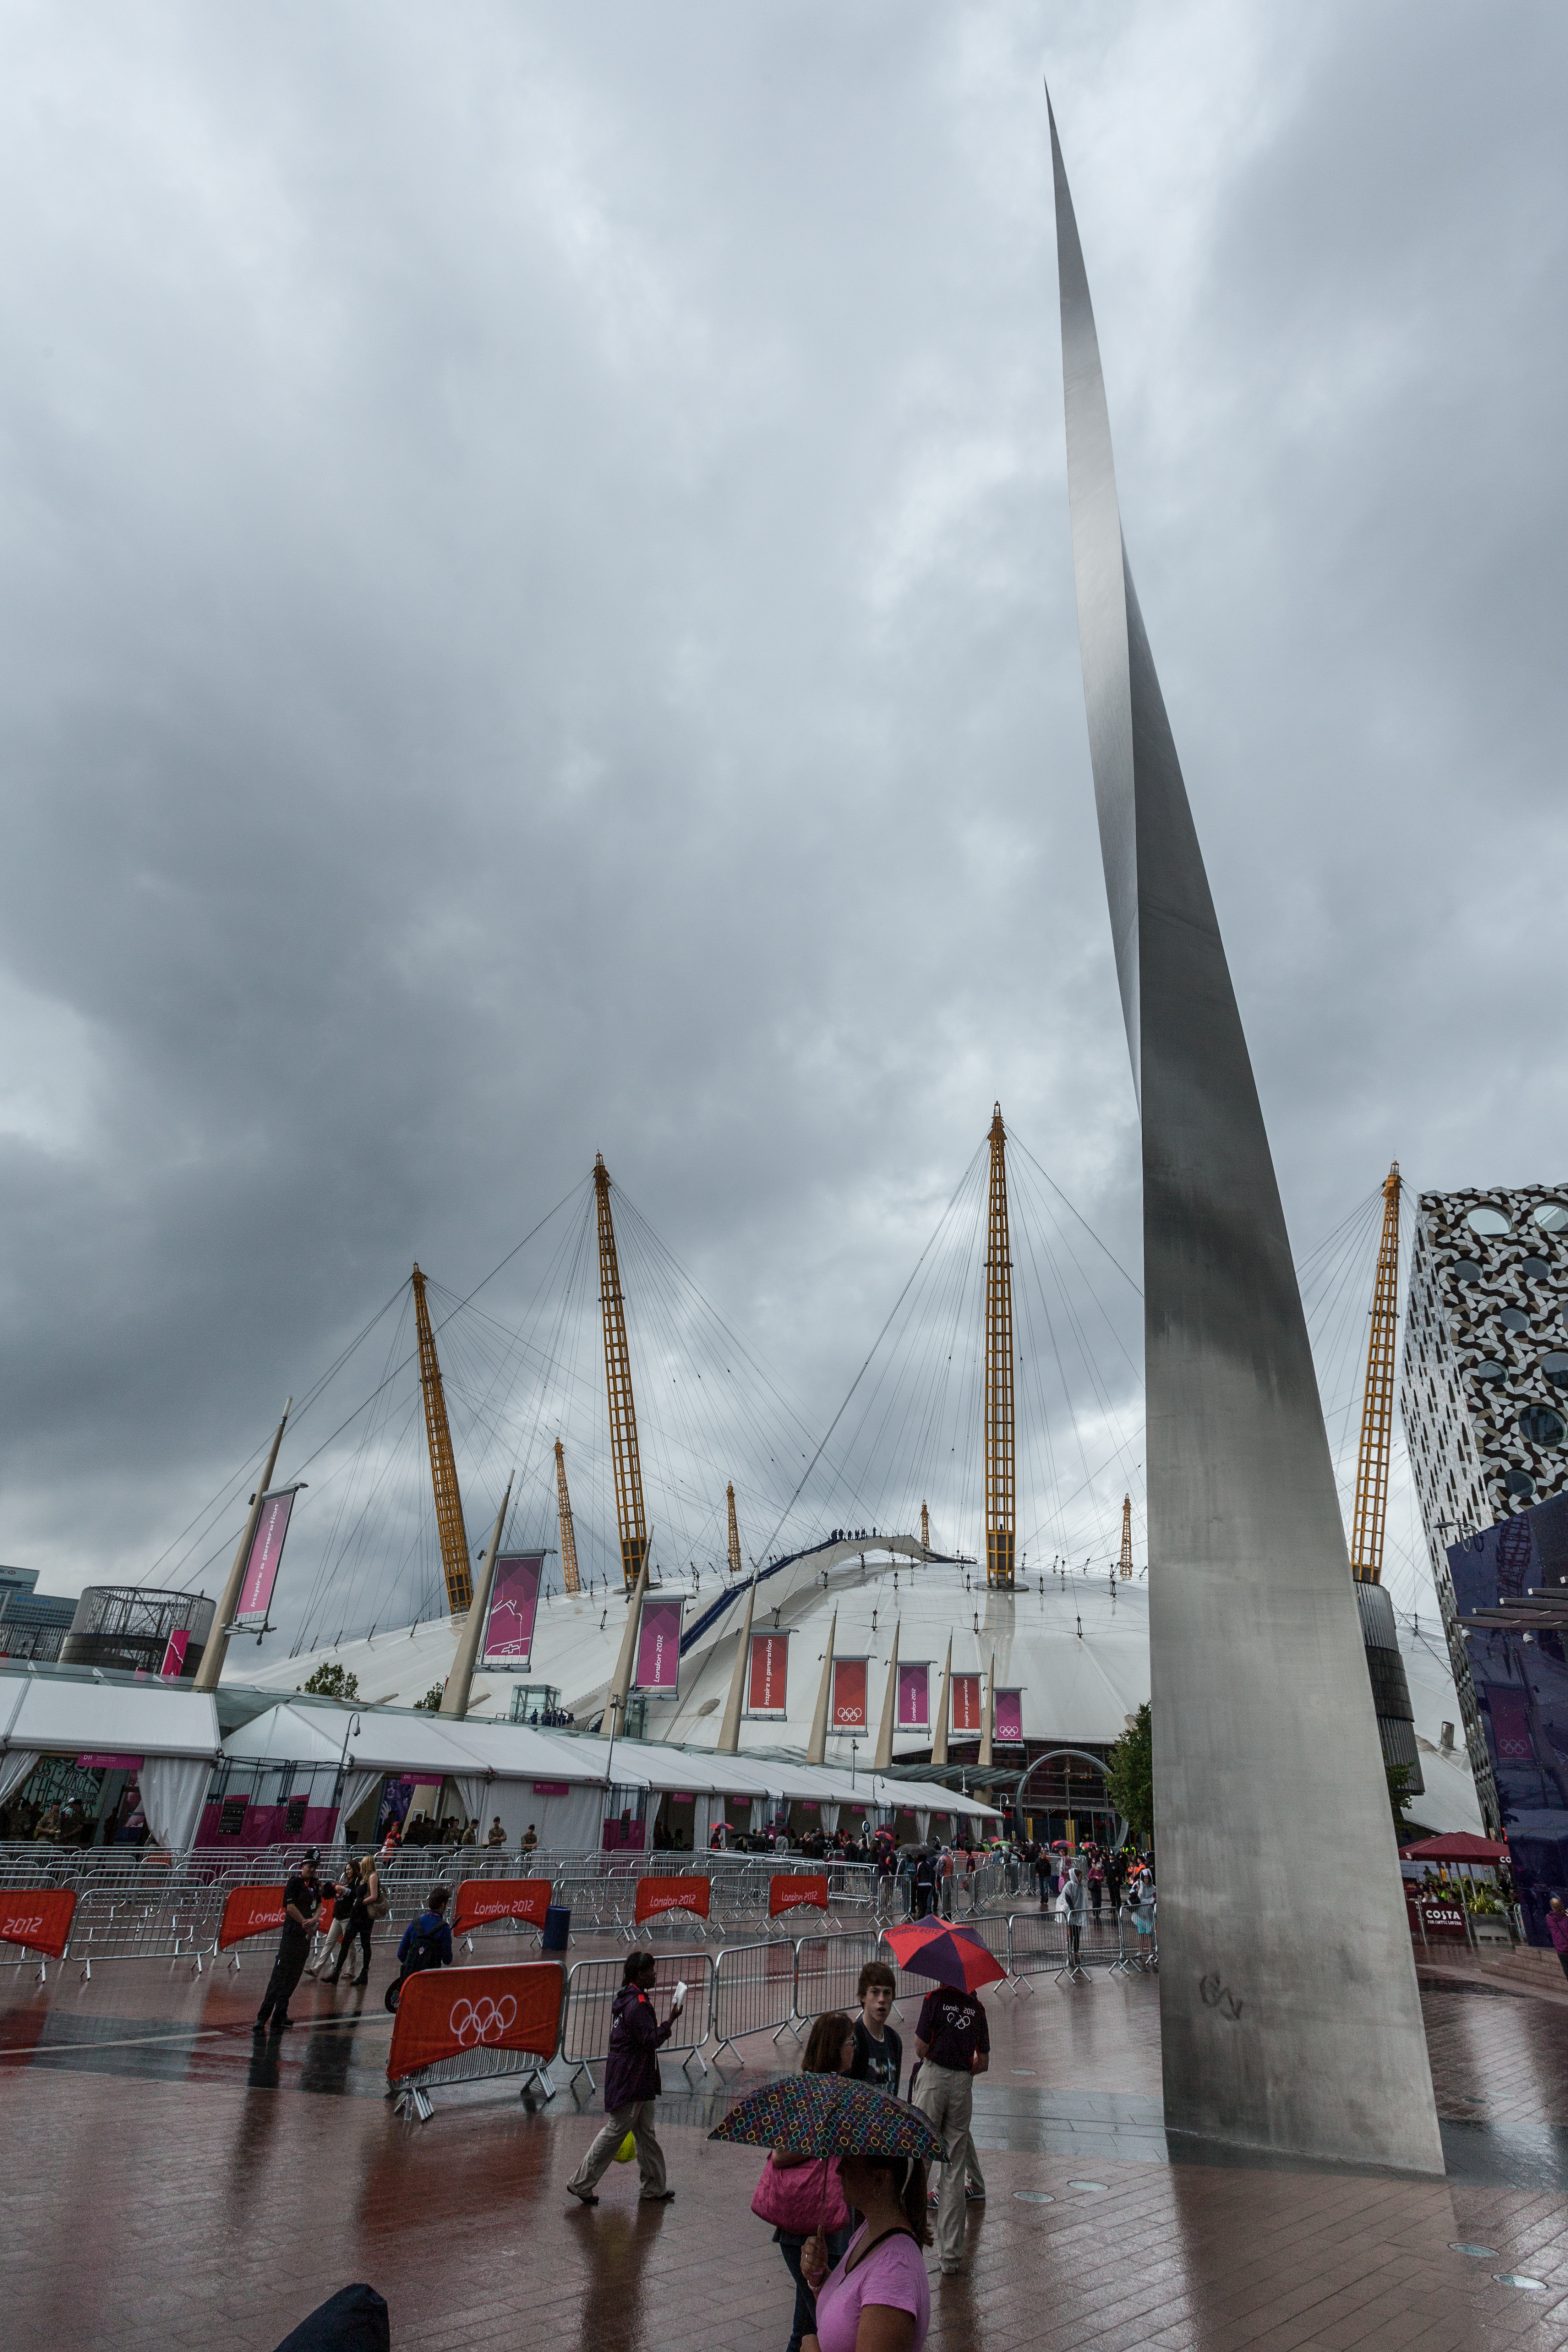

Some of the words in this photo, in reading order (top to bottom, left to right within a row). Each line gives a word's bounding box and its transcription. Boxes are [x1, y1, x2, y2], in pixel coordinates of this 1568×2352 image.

[250, 1572, 262, 1607] Inspire
[262, 1503, 279, 1561] generation
[656, 1634, 664, 1653] 2012
[765, 1639, 773, 1676] generation
[653, 1654, 662, 1683] London
[763, 1682, 771, 1706] Inspire
[650, 1895, 678, 1907] London
[679, 1894, 697, 1905] 2012
[781, 1891, 803, 1902] London
[804, 1891, 818, 1900] 2012
[248, 1907, 286, 1924] Londo
[474, 1901, 510, 1915] London
[511, 1900, 534, 1913] 2012
[1425, 1910, 1461, 1920] COSTA
[1, 1917, 43, 1934] 2012
[943, 2003, 960, 2012] Londo
[963, 2007, 976, 2016] 2012
